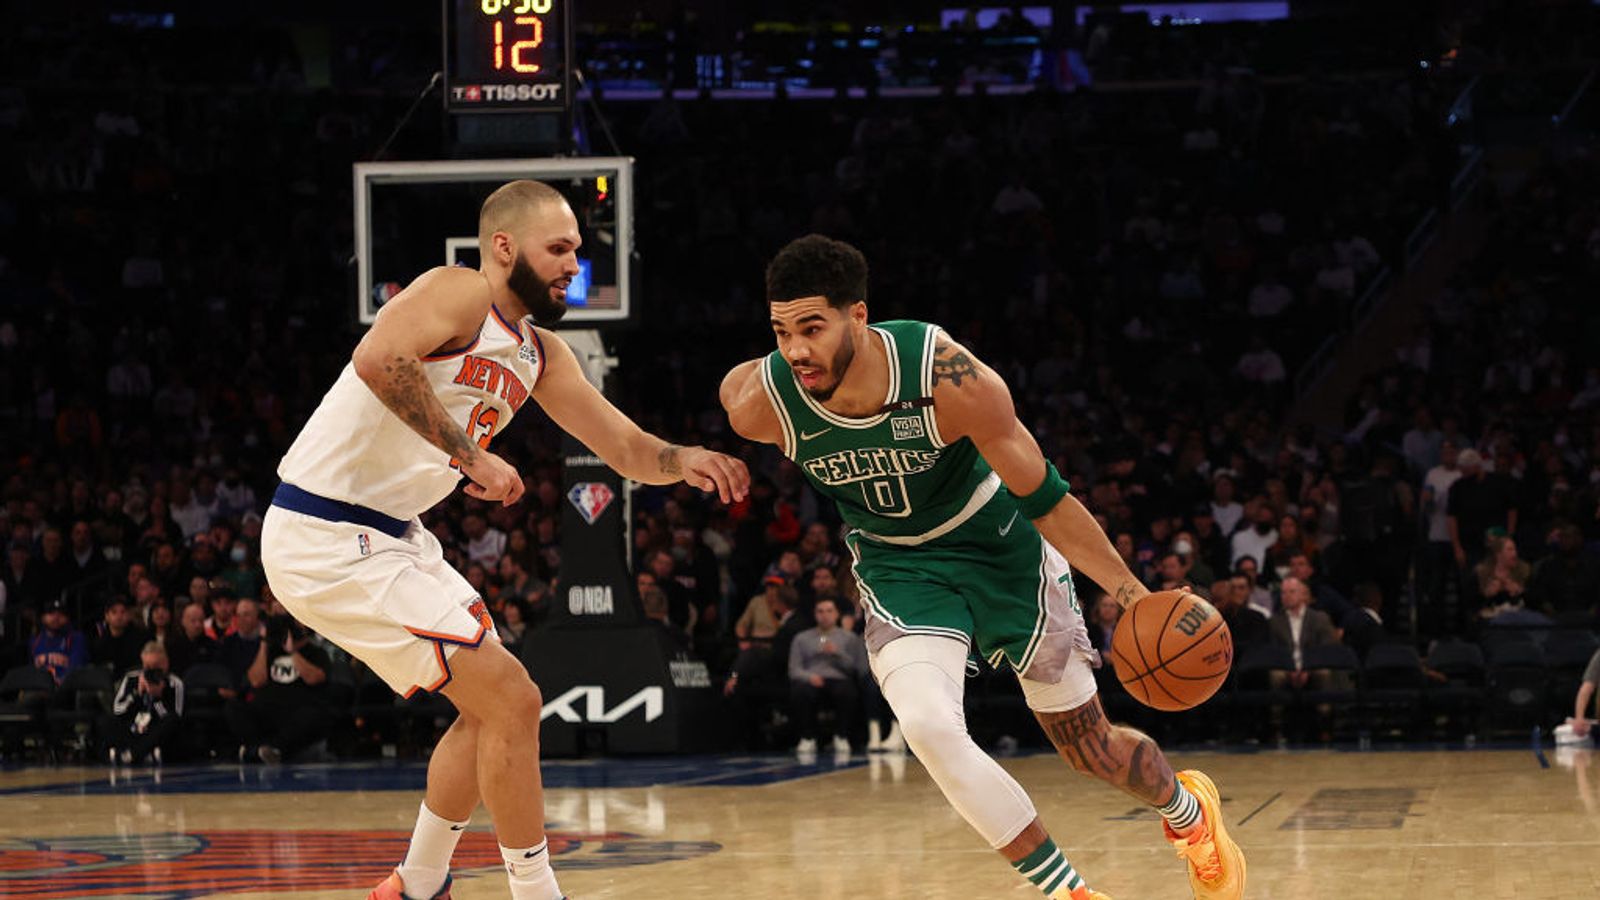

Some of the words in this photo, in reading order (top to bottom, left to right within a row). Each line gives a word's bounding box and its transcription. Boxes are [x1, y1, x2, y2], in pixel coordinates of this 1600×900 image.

[494, 16, 543, 73] 12
[482, 84, 561, 100] TISSOT
[453, 354, 503, 394] NEW
[803, 447, 940, 485] CELTICS
[860, 475, 912, 518] 0
[569, 586, 613, 615] @NBA
[540, 686, 663, 722] KIA
